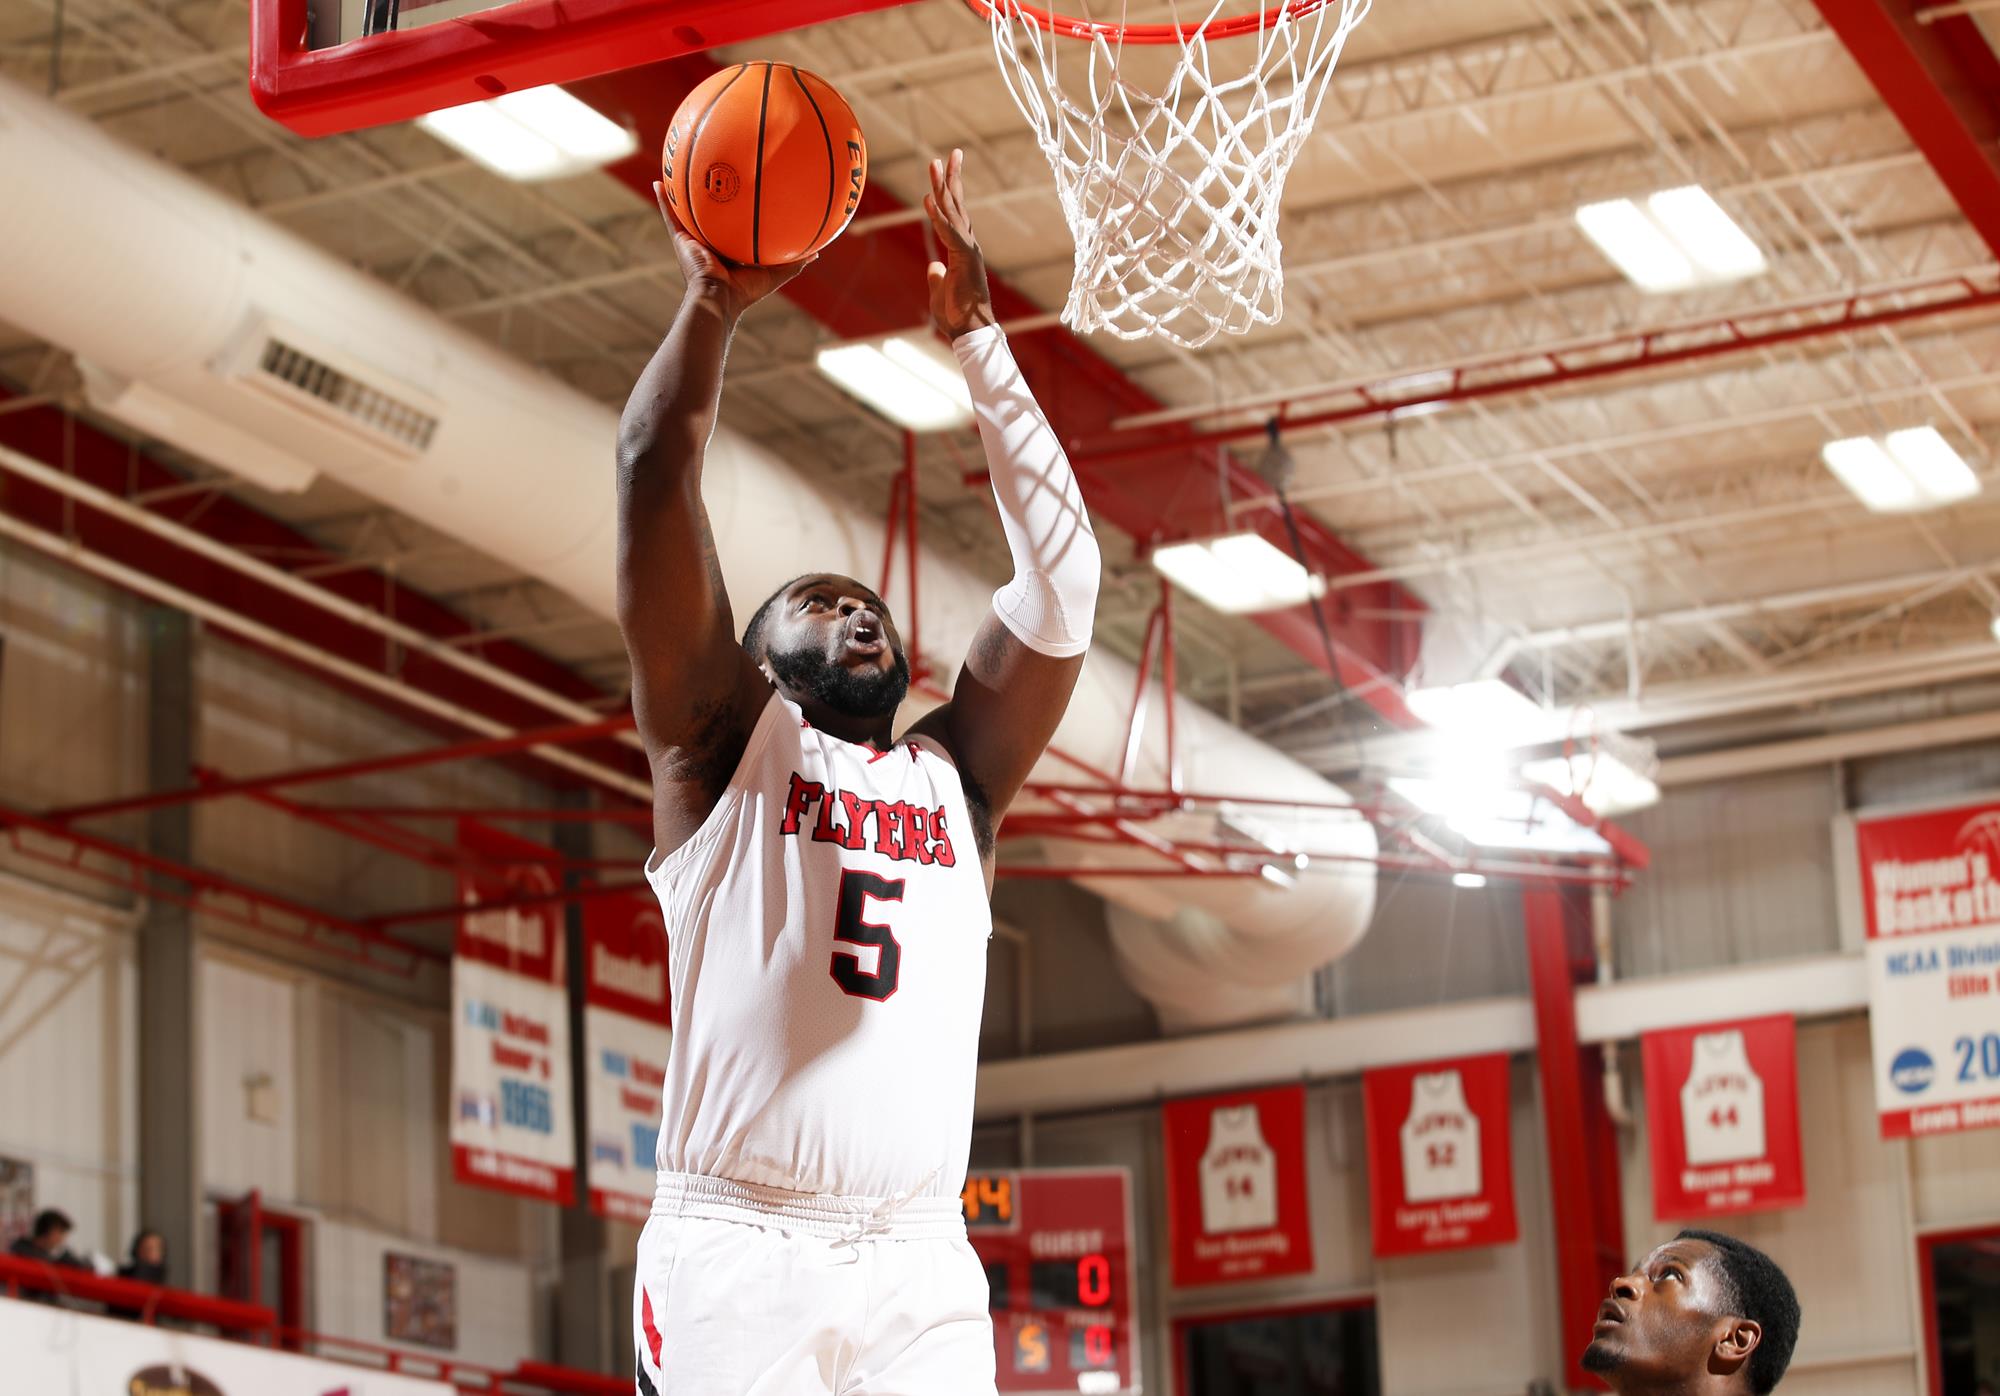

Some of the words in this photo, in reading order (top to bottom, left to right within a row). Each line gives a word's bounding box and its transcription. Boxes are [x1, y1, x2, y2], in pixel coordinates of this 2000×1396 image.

[780, 771, 956, 868] FLYERS
[830, 867, 905, 1002] 5
[1887, 950, 1940, 975] NCAA
[1955, 1033, 2000, 1083] 20
[1413, 1113, 1466, 1137] LEWIS
[1708, 1105, 1739, 1128] 44
[1078, 1253, 1111, 1306] 0
[1084, 1323, 1113, 1366] 0
